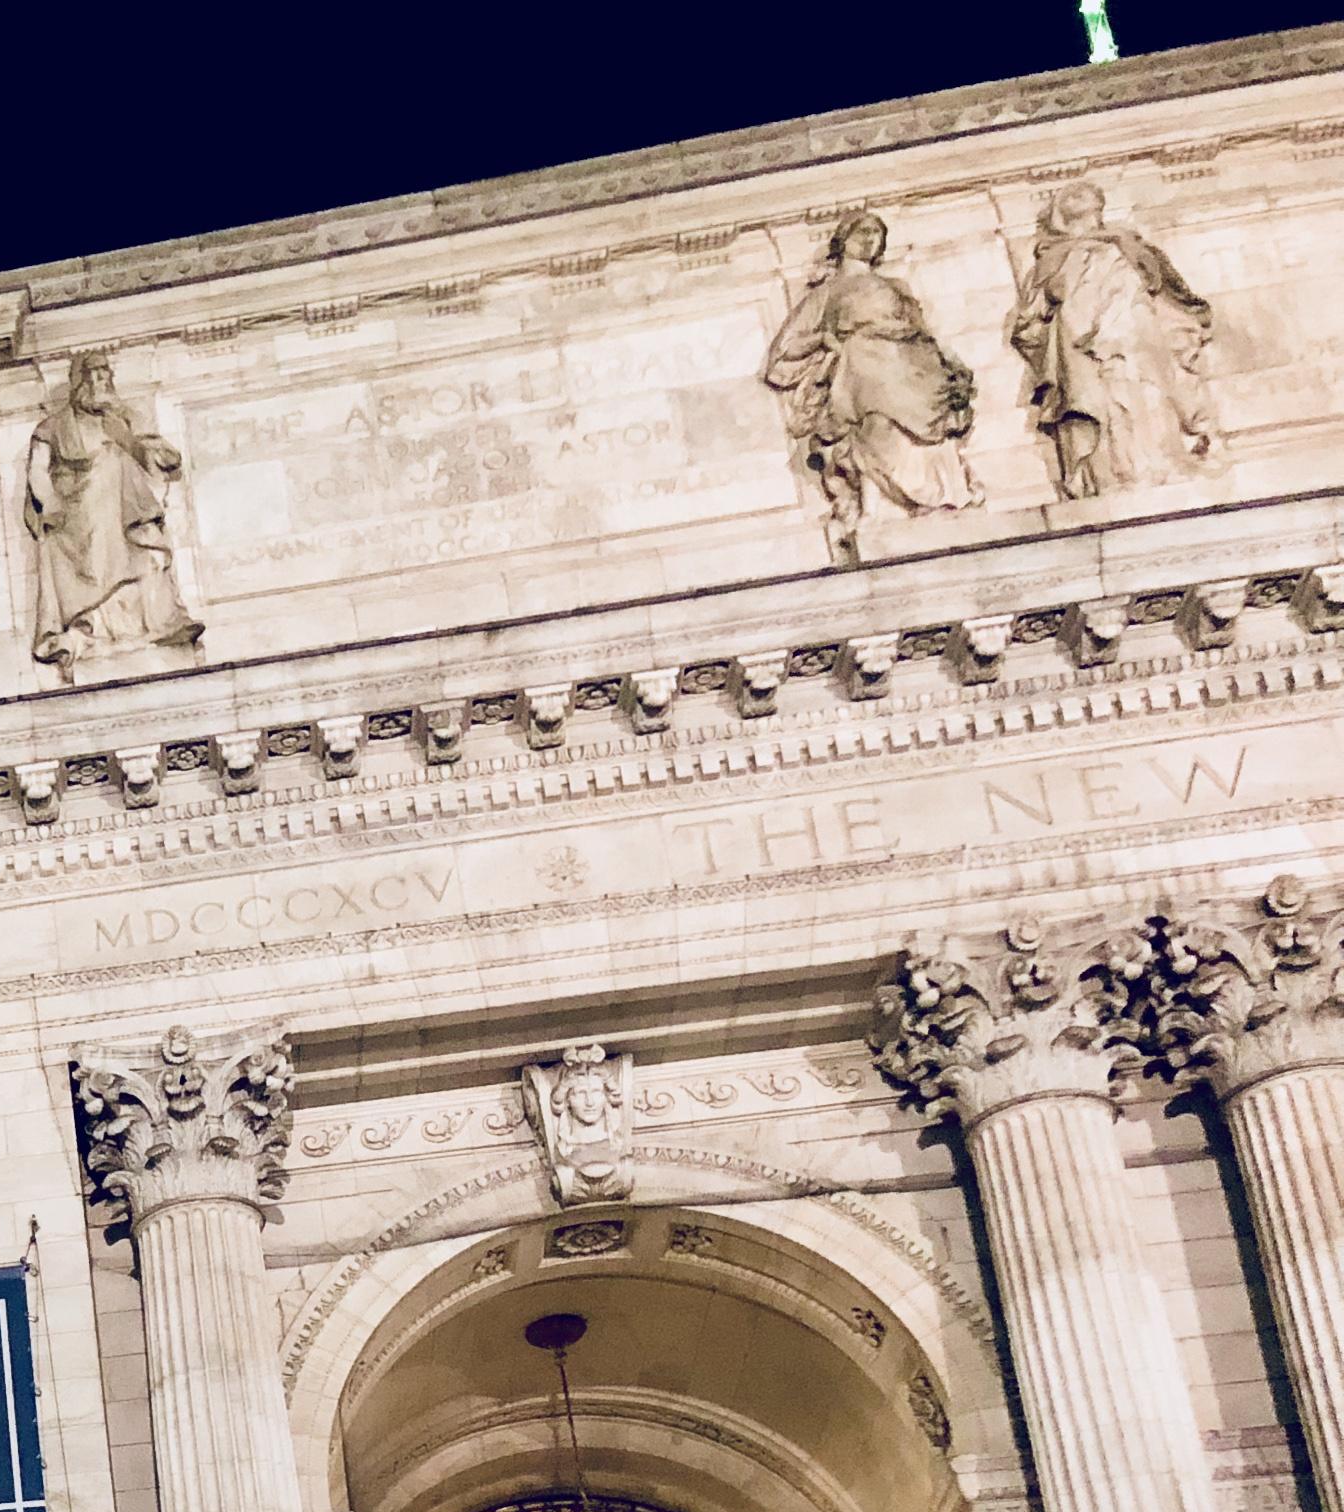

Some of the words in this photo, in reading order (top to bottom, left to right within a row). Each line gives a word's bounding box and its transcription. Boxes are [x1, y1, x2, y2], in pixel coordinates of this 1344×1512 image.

[344, 381, 494, 436] ASTOR
[404, 443, 532, 484] JACOB
[558, 420, 672, 462] ASTOR
[438, 508, 476, 532] OF
[93, 867, 455, 952] MDCCCXCV
[671, 795, 902, 876] THE
[982, 744, 1251, 835] NEW
